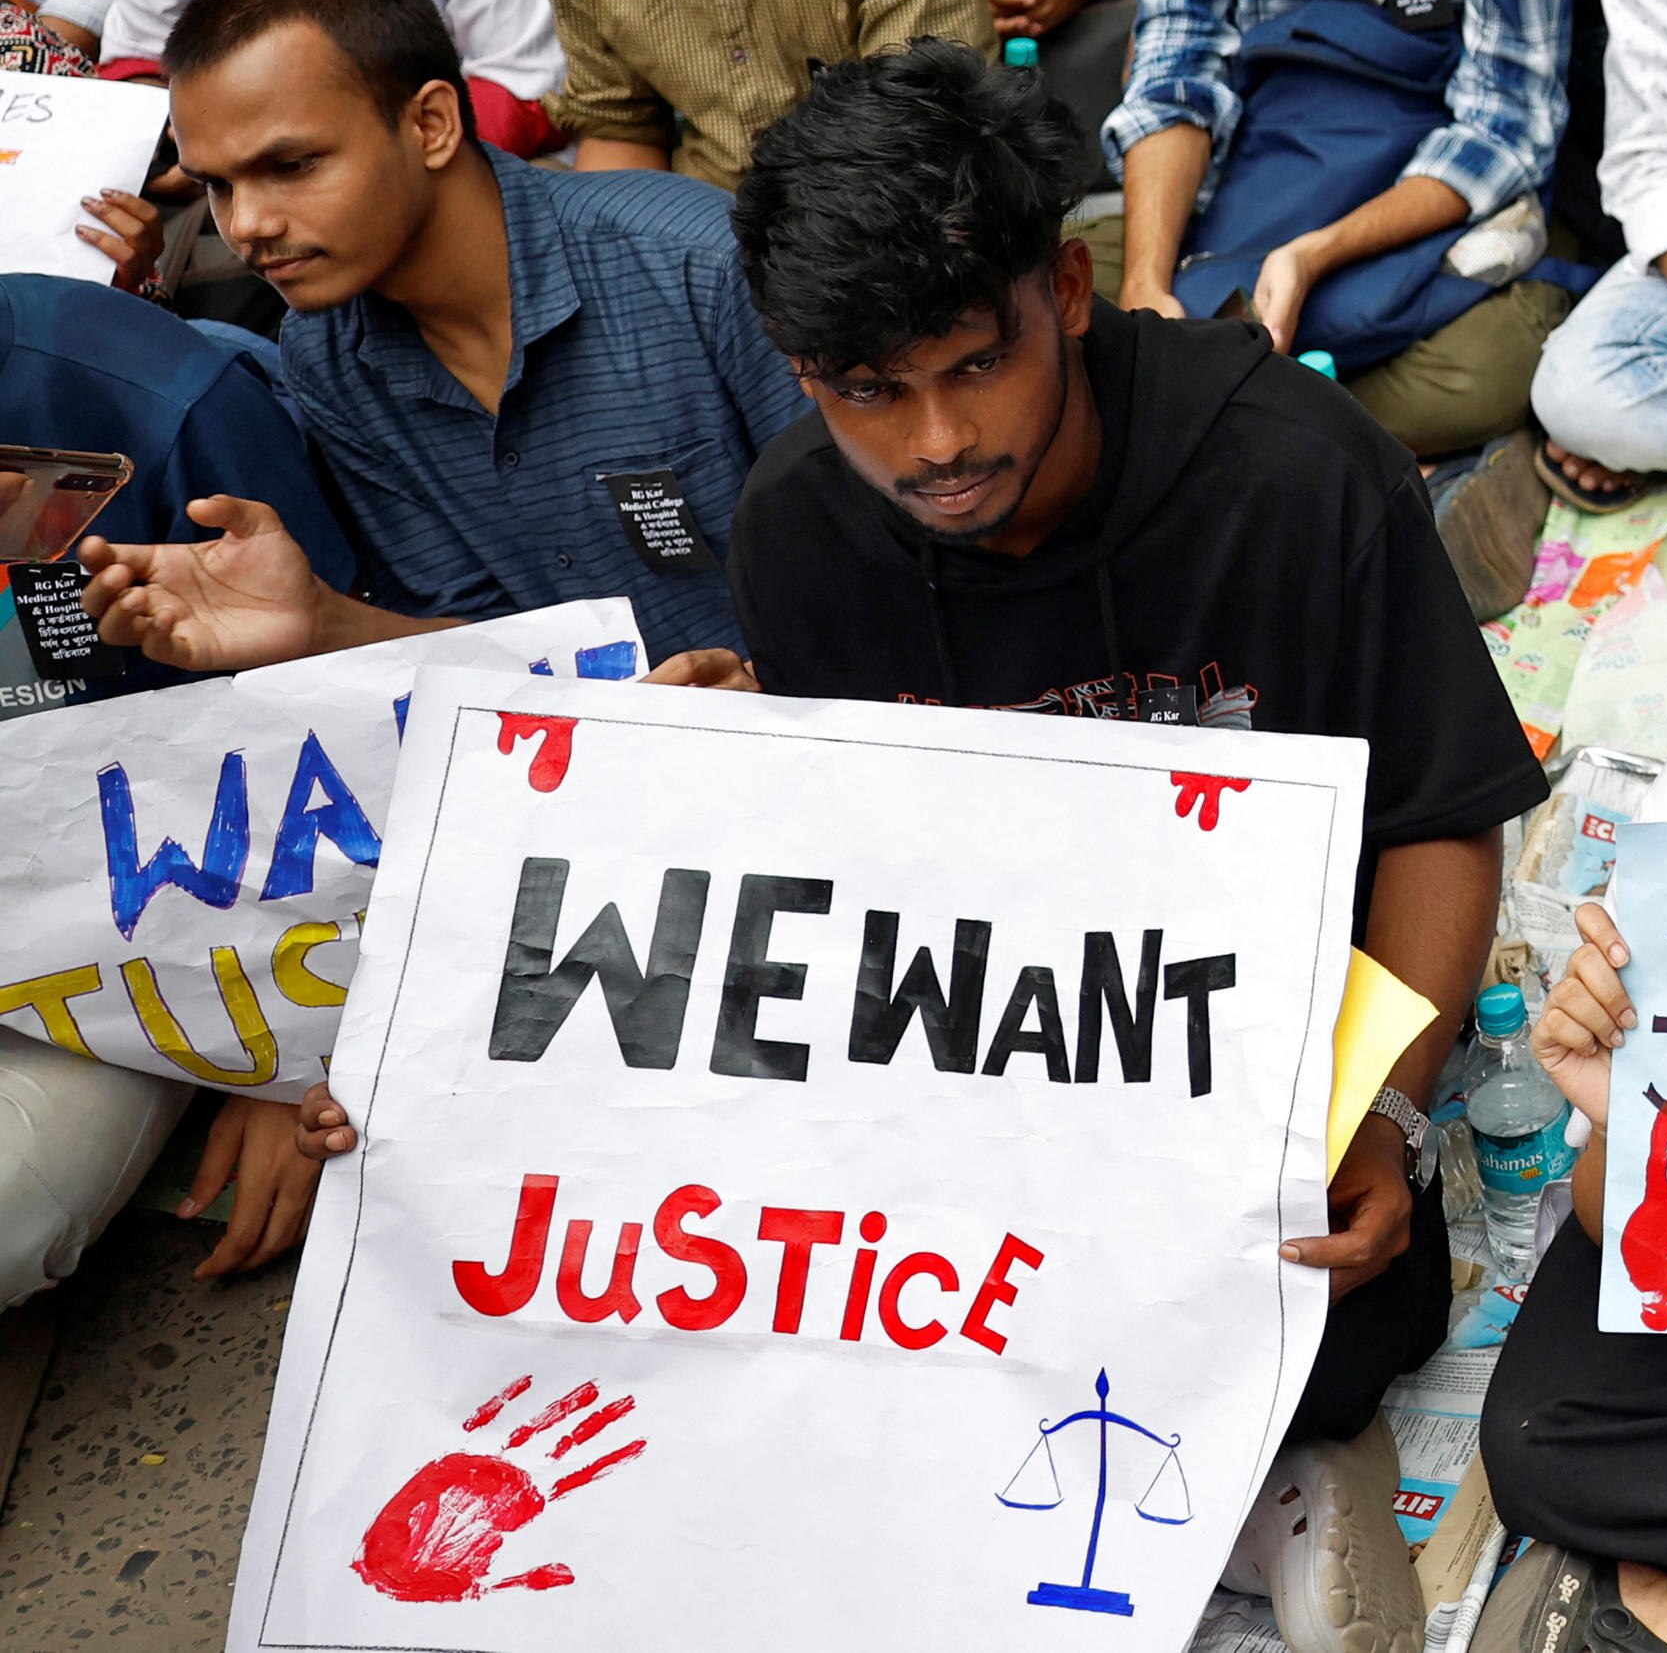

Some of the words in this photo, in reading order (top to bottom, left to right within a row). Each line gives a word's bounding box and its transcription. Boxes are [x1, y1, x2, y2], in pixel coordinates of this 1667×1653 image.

[0, 88, 53, 123] ES
[631, 489, 645, 500] RG
[645, 489, 664, 499] Kar
[620, 501, 652, 512] Medical
[652, 497, 684, 509] College
[642, 508, 679, 521] Hospital
[34, 580, 52, 591] RG
[54, 578, 76, 589] Kar
[17, 592, 58, 605] Medical
[32, 606, 42, 616] &
[45, 601, 83, 615] Hospit
[1163, 710, 1180, 721] Kar
[488, 856, 833, 1082] WE
[848, 908, 1237, 1099] WANT
[1392, 1493, 1437, 1515] LIF
